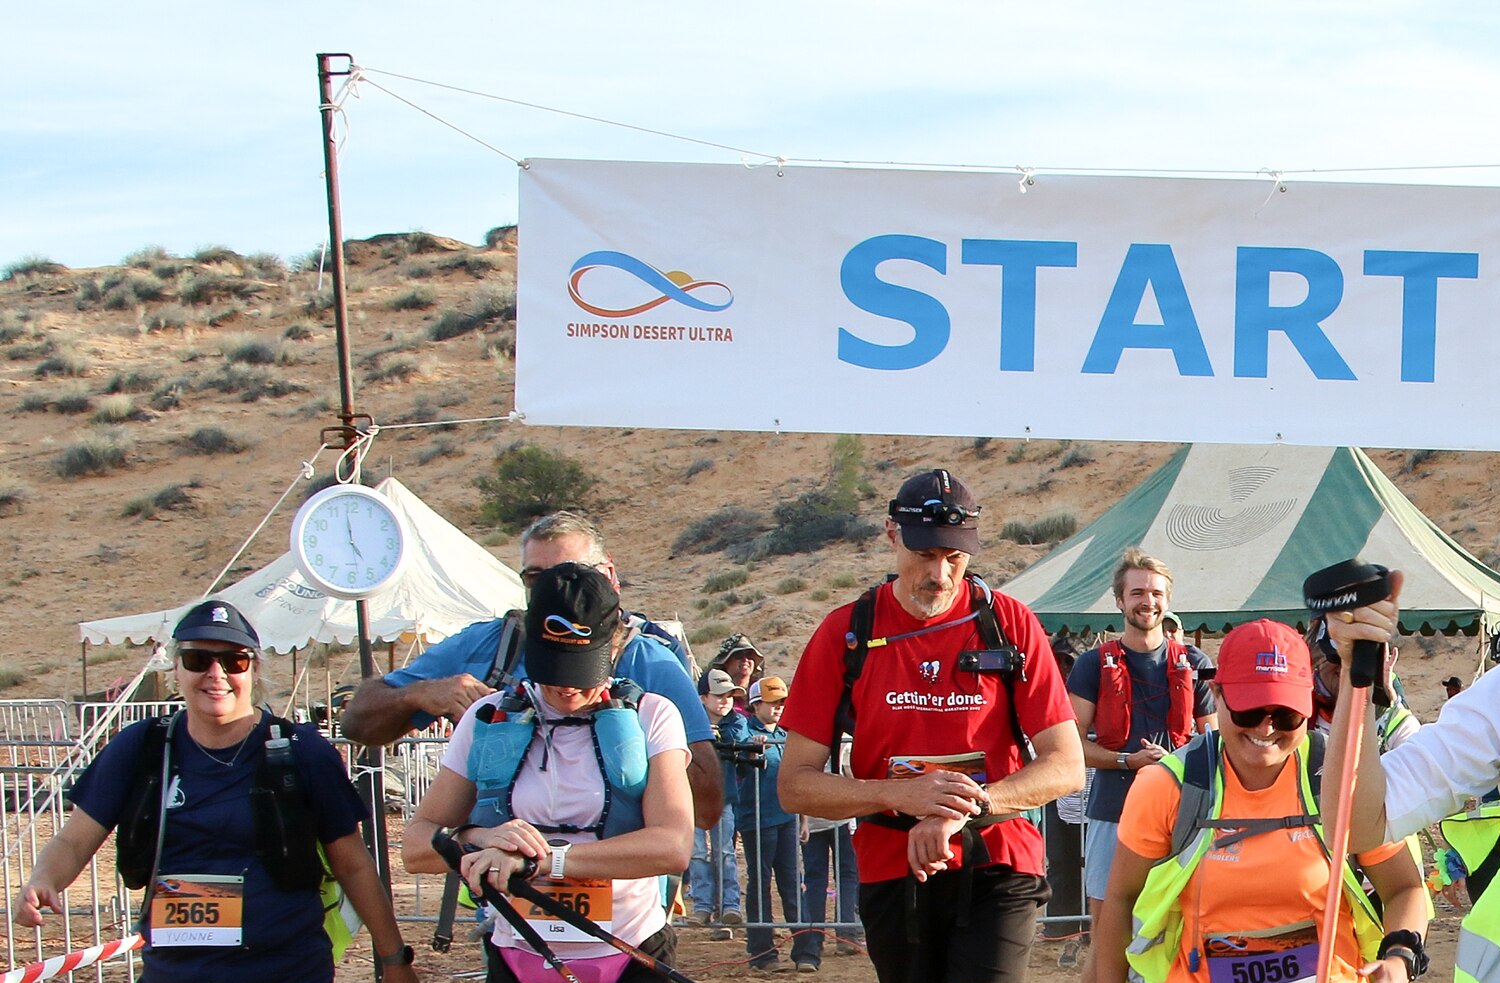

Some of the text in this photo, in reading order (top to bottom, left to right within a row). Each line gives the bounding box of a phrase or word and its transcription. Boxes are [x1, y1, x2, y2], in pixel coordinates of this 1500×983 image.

[837, 232, 1479, 384] START
[566, 322, 734, 343] SIMPSON DESERT ULTRA
[328, 506, 339, 517] 11
[344, 502, 359, 513] 12
[367, 507, 373, 518] 1
[314, 519, 328, 532] 10
[380, 520, 389, 532] 2
[309, 535, 317, 548] 9
[386, 538, 395, 550] 3
[315, 554, 324, 567] 8
[380, 555, 389, 568] 4
[329, 565, 338, 578] 7
[347, 571, 357, 584] 6
[366, 567, 374, 580] 5
[947, 691, 988, 706] done.
[164, 902, 220, 925] 2565
[549, 924, 565, 933] Lisa
[166, 931, 214, 943] YVONNE
